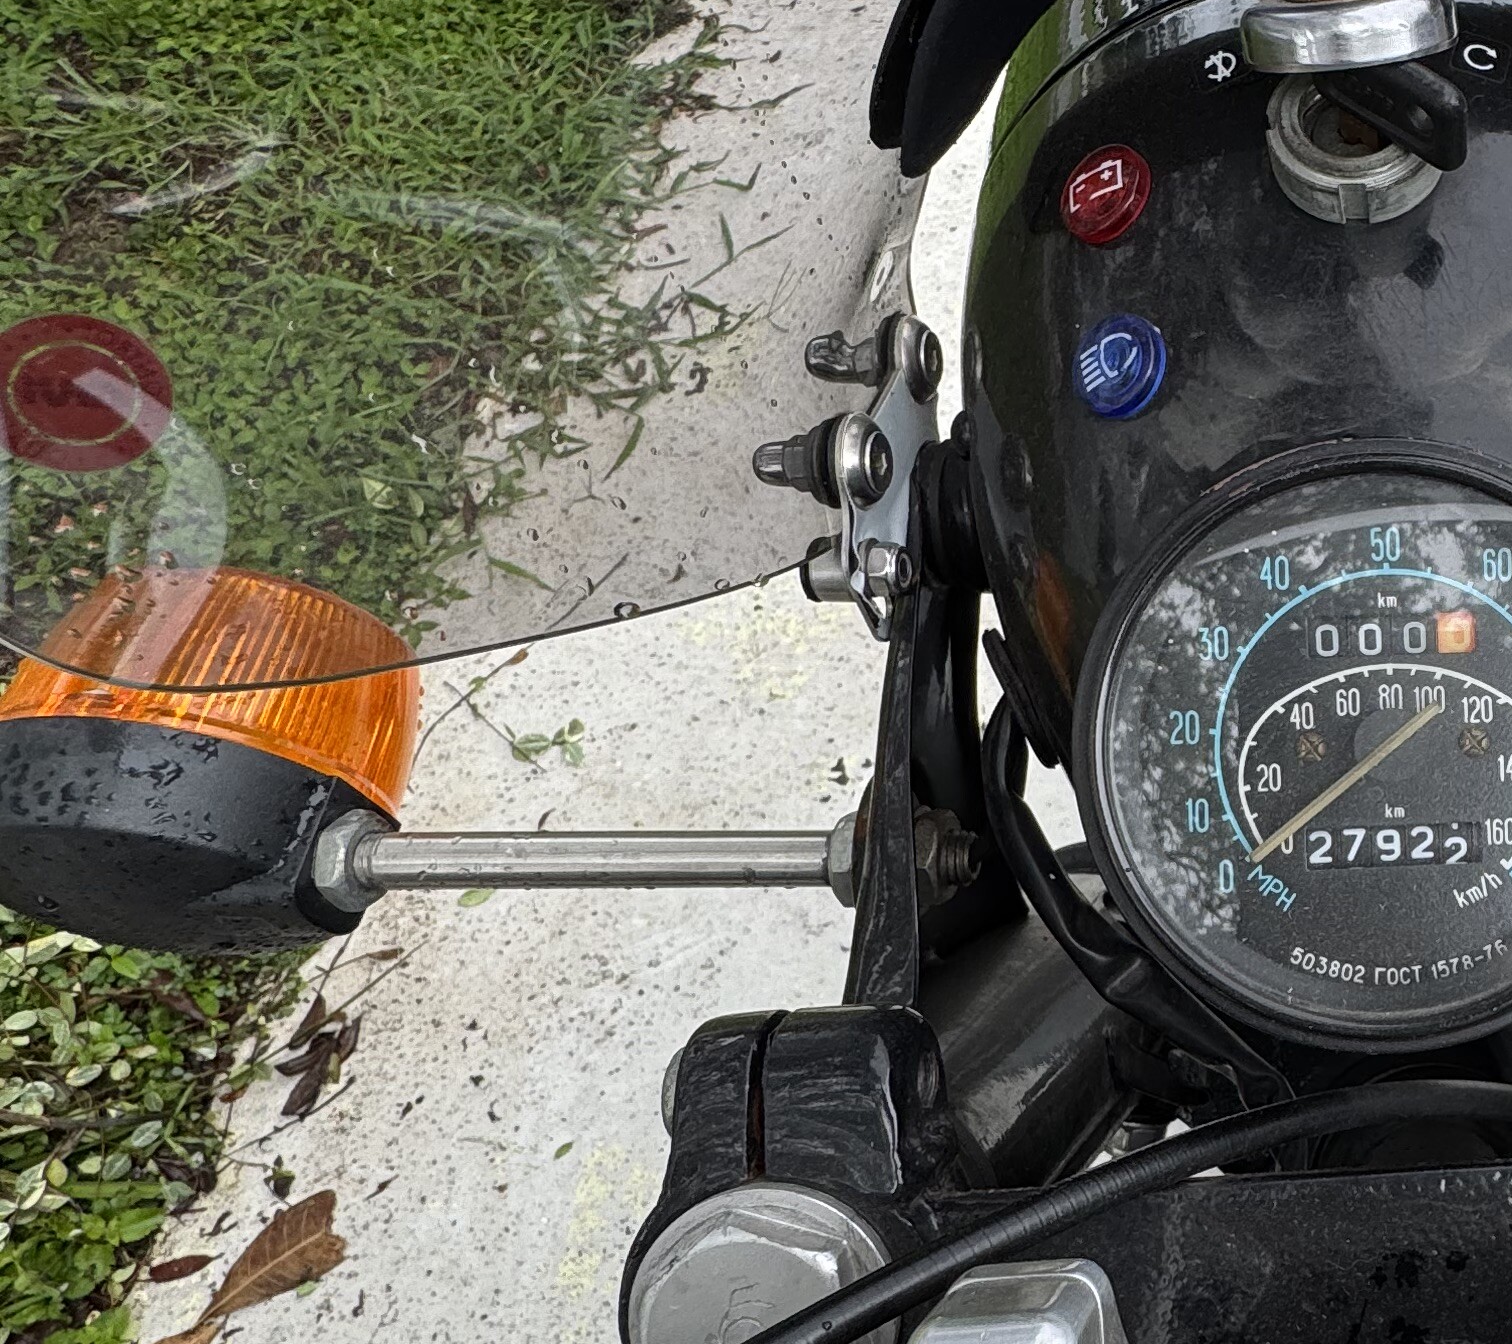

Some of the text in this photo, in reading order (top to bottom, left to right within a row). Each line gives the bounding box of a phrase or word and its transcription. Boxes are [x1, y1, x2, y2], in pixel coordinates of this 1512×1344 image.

[1370, 528, 1400, 561] 50
[1259, 555, 1290, 591] 40
[1482, 547, 1512, 582] 60
[1377, 592, 1398, 608] km
[1198, 626, 1230, 661] 30
[1335, 688, 1360, 717] 60
[1378, 683, 1403, 710] 80
[1413, 685, 1446, 714] 100
[1462, 695, 1494, 724] 120
[1168, 711, 1200, 745] 20
[1289, 702, 1315, 730] 40
[1256, 763, 1282, 792] 20
[1185, 797, 1210, 834] 10
[1384, 803, 1405, 819] km
[1219, 859, 1235, 894] 0
[1246, 864, 1297, 913] MPH
[1453, 872, 1503, 909] km/h
[1374, 965, 1422, 986] ГОСТ
